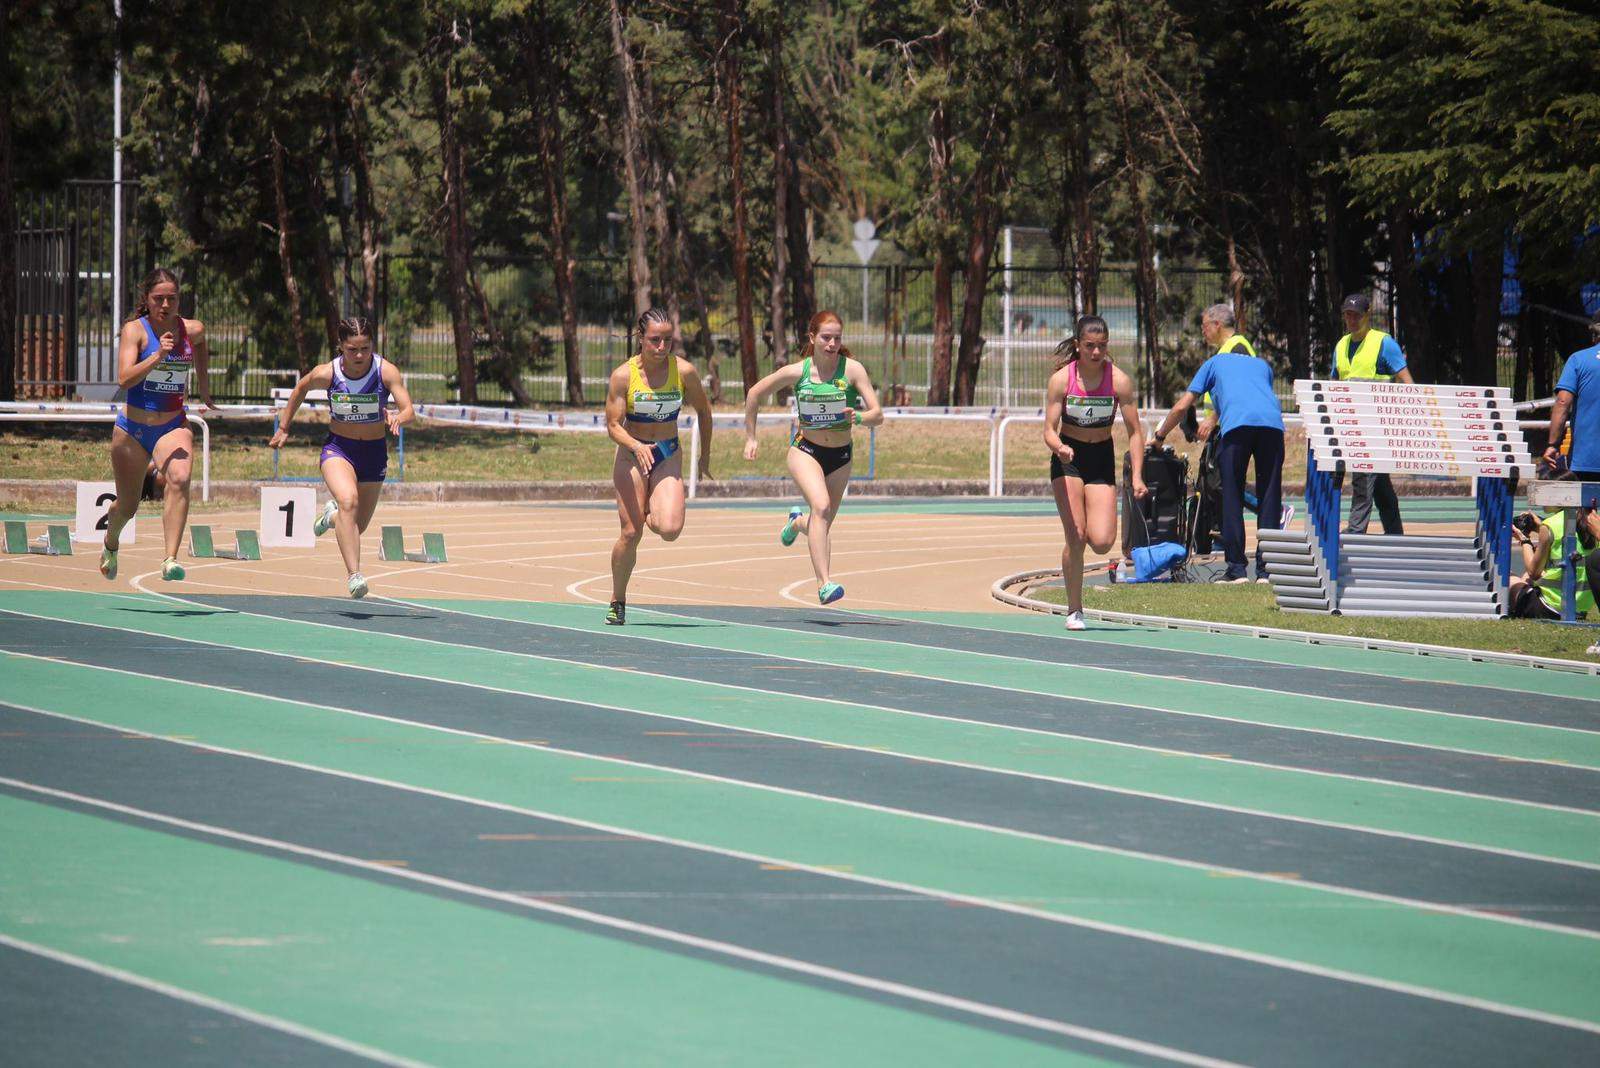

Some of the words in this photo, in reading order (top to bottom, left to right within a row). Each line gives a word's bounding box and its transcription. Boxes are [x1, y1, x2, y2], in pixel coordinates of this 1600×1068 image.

[165, 371, 174, 383] 2
[1371, 384, 1419, 394] BURGOS
[1374, 395, 1422, 404] BURGOS
[351, 404, 359, 414] 8
[656, 403, 664, 413] 7
[819, 403, 827, 413] 3
[1086, 407, 1093, 417] 4
[1377, 406, 1425, 415] BURGOS
[1380, 418, 1428, 426] BURGOS
[1383, 428, 1432, 437] BURGOS
[1388, 439, 1436, 448] BURGOS
[1392, 450, 1440, 459] BURGOS
[1396, 460, 1444, 470] BURGOS
[95, 493, 118, 531] 2
[278, 500, 295, 537] 1
